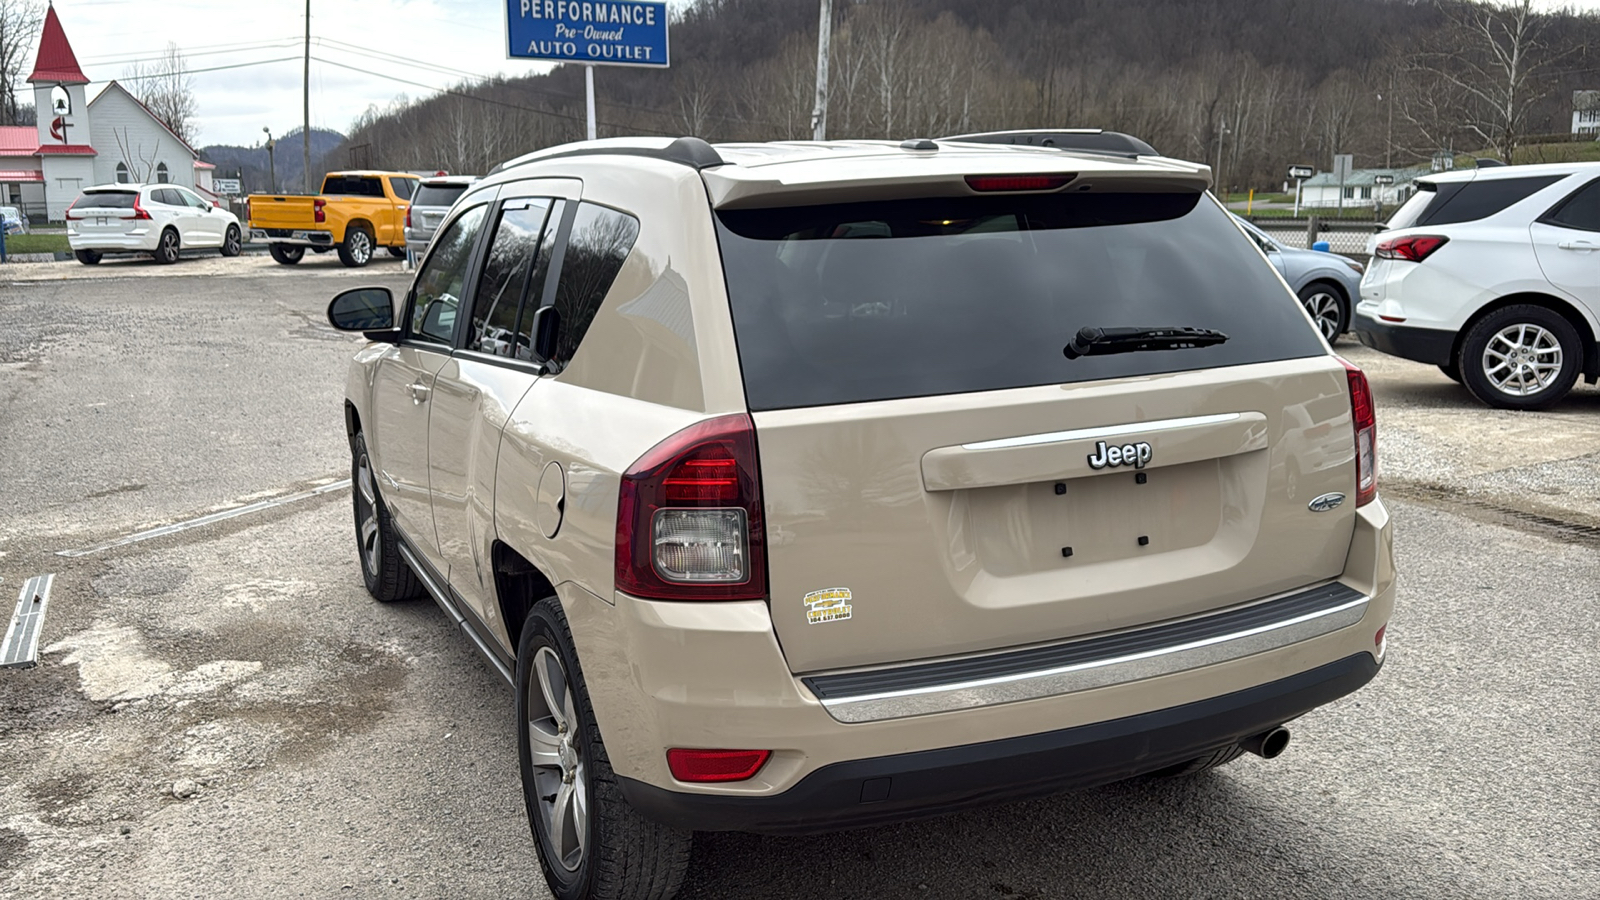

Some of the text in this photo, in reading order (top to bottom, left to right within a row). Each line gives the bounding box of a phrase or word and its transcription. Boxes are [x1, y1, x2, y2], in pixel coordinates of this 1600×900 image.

[520, 0, 656, 25] PERFORMANCE
[555, 23, 624, 41] Pre-Owned
[528, 40, 653, 60] AUTO OUTLET
[1087, 441, 1152, 470] Jeep
